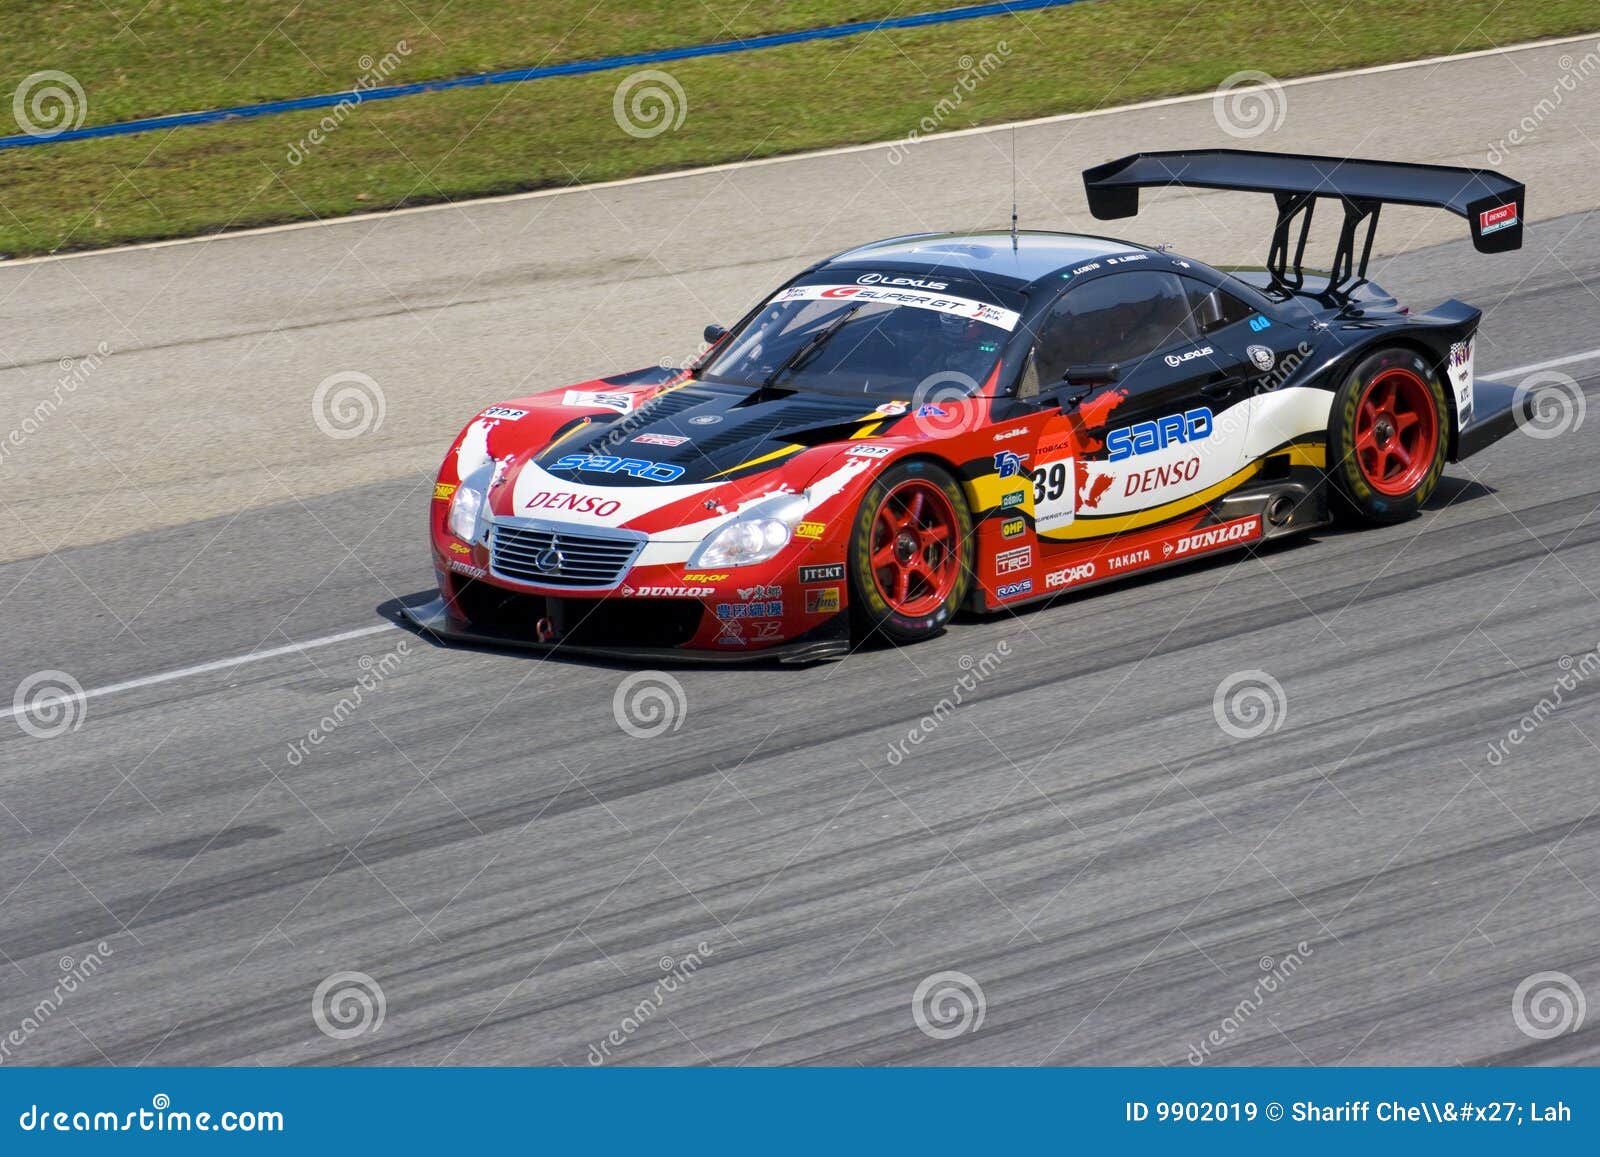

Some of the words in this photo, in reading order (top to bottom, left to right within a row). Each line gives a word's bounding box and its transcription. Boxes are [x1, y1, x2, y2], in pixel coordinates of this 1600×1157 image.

[881, 276, 948, 290] LEXUS
[856, 291, 931, 304] SUPER
[930, 300, 965, 309] GT
[1179, 346, 1214, 362] LEXUS
[1034, 462, 1066, 506] 39
[1124, 457, 1200, 497] DENSO
[525, 491, 622, 517] DENSO
[796, 524, 825, 538] OMP
[1002, 520, 1024, 538] OMP
[1175, 520, 1258, 554] DUNLOP
[998, 555, 1029, 571] TRD
[1108, 550, 1150, 569] TAKATA
[804, 566, 842, 581] JTEKT
[1046, 562, 1095, 588] RECARO
[636, 587, 716, 597] DUNLOP
[997, 580, 1031, 596] RAYS
